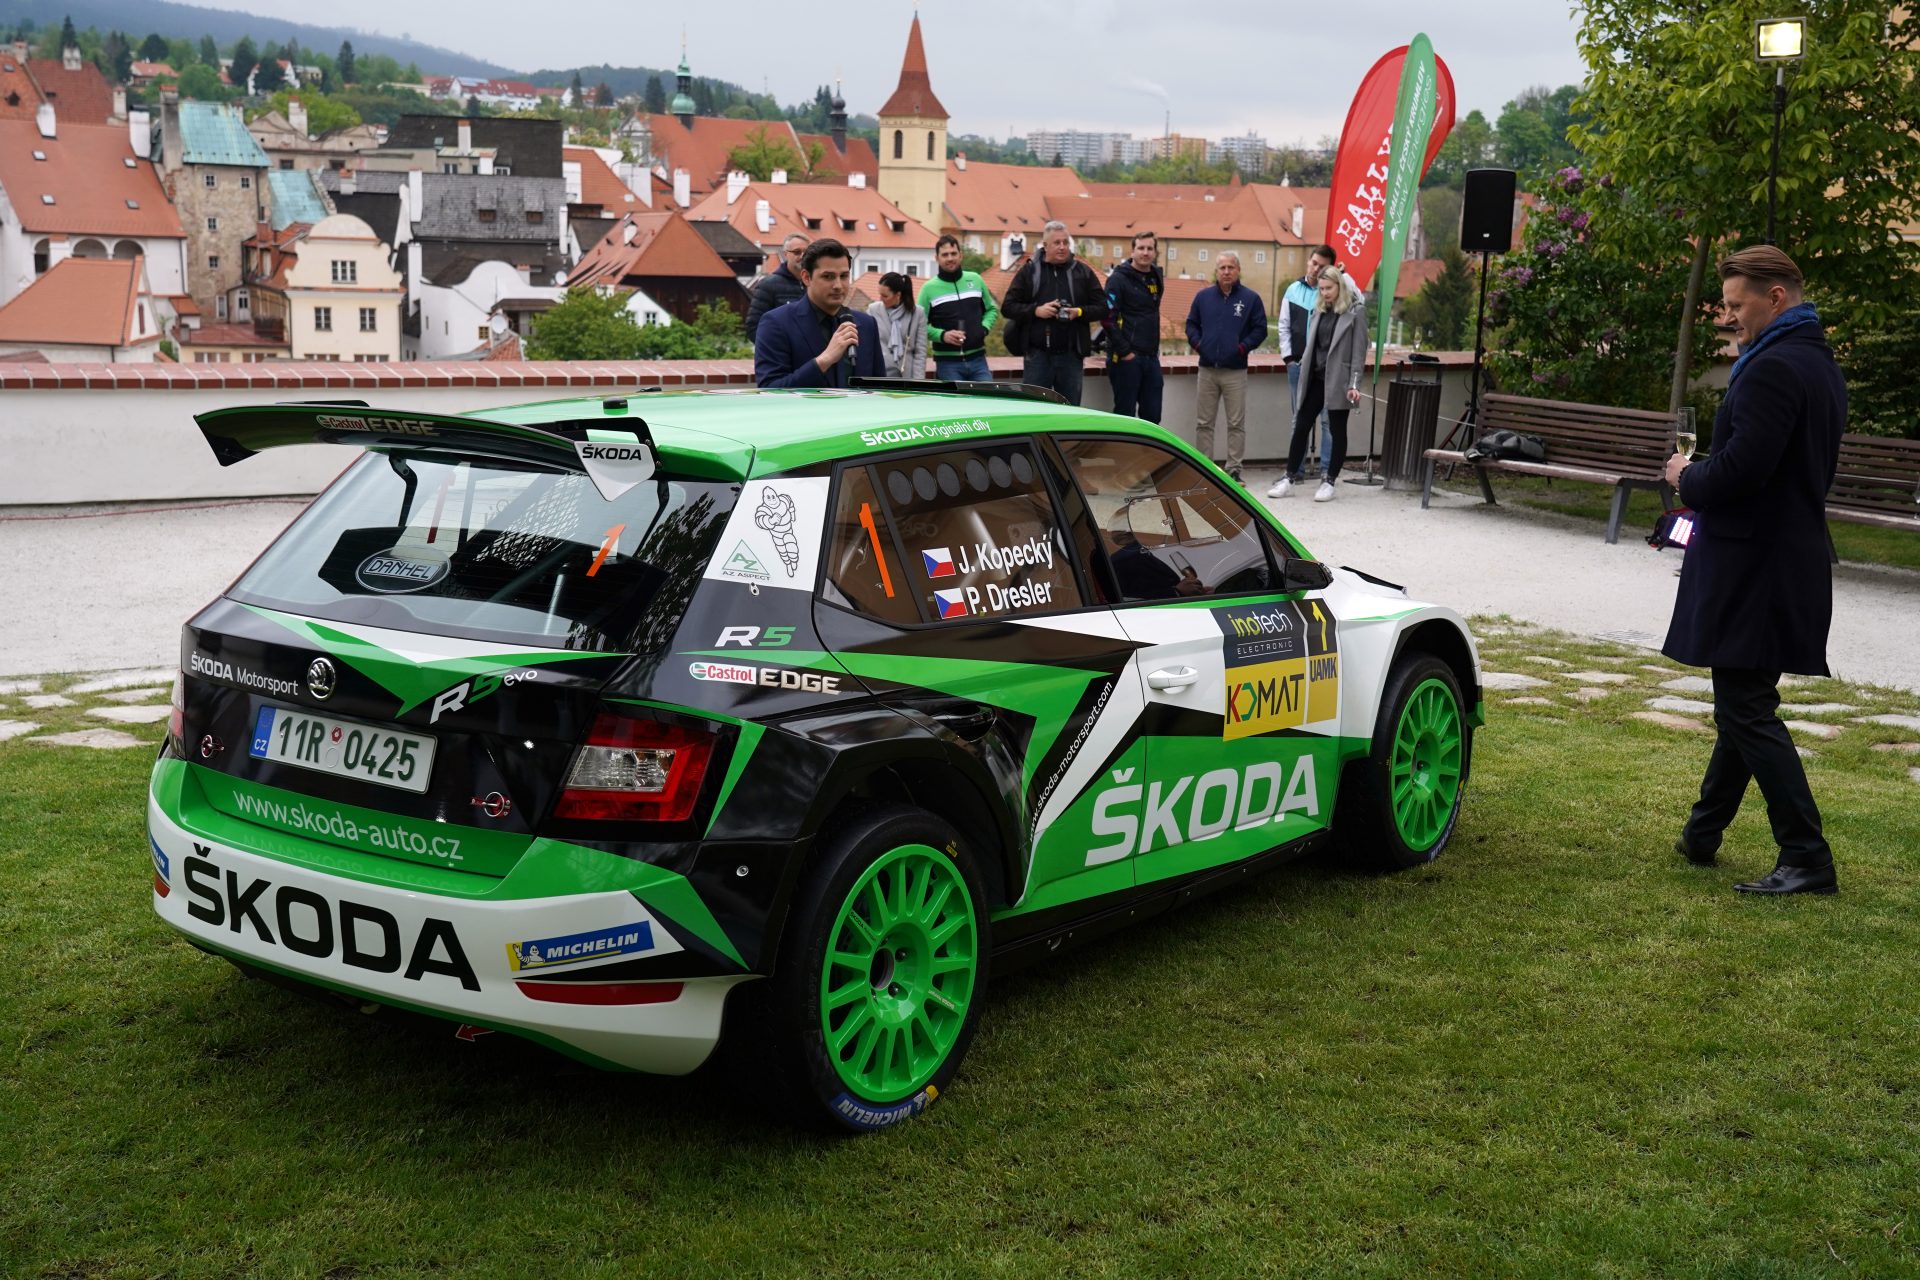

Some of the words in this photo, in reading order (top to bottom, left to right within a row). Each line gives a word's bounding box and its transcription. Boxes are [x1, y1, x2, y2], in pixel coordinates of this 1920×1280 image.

[1409, 60, 1425, 128] KRUMLOV
[1407, 74, 1432, 175] Energies
[1336, 122, 1393, 238] RALLY
[329, 417, 366, 430] Castrol
[367, 417, 440, 436] EDGE
[860, 427, 924, 447] ŠKODA
[922, 420, 973, 438] Originální
[972, 419, 991, 433] díly
[582, 443, 642, 461] ŠKODA
[586, 523, 626, 577] 1
[858, 502, 895, 598] 1
[958, 545, 975, 575] J.
[975, 534, 1053, 575] Kopecký
[737, 572, 771, 581] ASPECT
[966, 586, 987, 615] P.
[986, 578, 1052, 612] Dresler
[714, 626, 796, 648] R5
[1227, 608, 1293, 638] inotech
[1312, 601, 1328, 652] 1
[1237, 640, 1293, 655] ELECTRONIC
[191, 651, 234, 682] ŠKODA
[236, 666, 299, 696] Motorsport
[707, 665, 753, 682] Castrol
[759, 667, 842, 695] EDGE
[429, 668, 512, 725] R5
[503, 669, 538, 687] evo
[1226, 673, 1304, 725] KOMAT
[254, 738, 267, 751] CZ
[279, 716, 325, 763] 11R
[343, 729, 419, 782] 0425
[1029, 681, 1113, 843] www.skoda-motorsport.com
[233, 790, 464, 860] www.skoda-auto.cz
[1084, 753, 1319, 867] ŠKODA
[184, 842, 482, 992] ŠKODA
[547, 932, 639, 959] MICHELIN
[838, 1097, 914, 1125] MICHELIN
